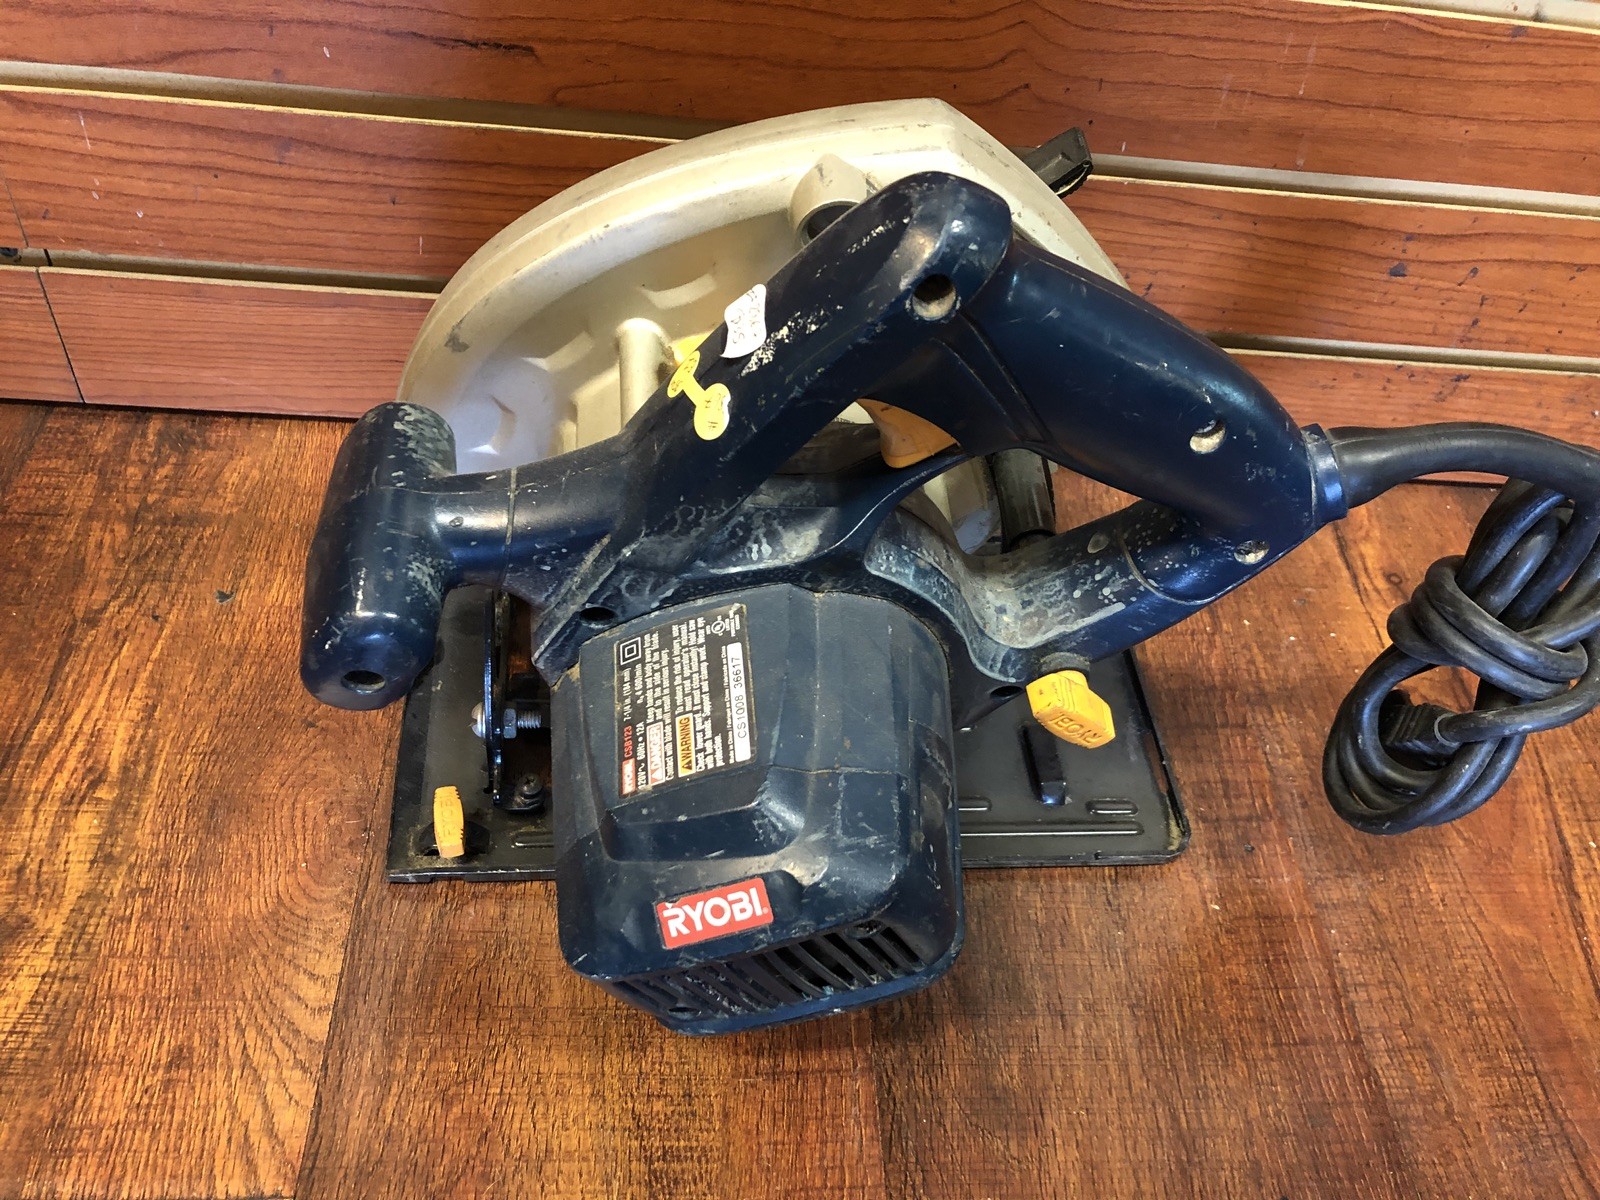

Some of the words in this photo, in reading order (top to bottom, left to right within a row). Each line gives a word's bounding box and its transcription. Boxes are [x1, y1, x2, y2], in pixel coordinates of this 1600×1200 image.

[698, 616, 706, 627] eye
[651, 630, 659, 650] blade.
[679, 621, 688, 646] manual.
[688, 631, 696, 645] Hold
[697, 628, 705, 644] Wear
[645, 647, 653, 663] away
[652, 651, 660, 662] the
[659, 647, 669, 667] injury.
[698, 644, 706, 661] work.
[644, 662, 653, 677] body
[652, 662, 660, 670] of
[673, 662, 681, 675] risk
[699, 661, 710, 680] clamp
[731, 655, 742, 689] 36617
[645, 676, 653, 689] and
[653, 671, 661, 685] side
[661, 666, 669, 688] serious
[673, 674, 682, 685] the
[691, 672, 699, 689] close
[653, 686, 661, 698] the
[683, 679, 691, 694] read
[700, 680, 709, 693] and
[645, 688, 653, 708] hands
[662, 694, 671, 713] result
[674, 685, 683, 706] reduce
[684, 695, 692, 711] must
[692, 689, 700, 705] must
[623, 704, 632, 721] 7-1/4
[675, 706, 683, 714] To
[701, 692, 712, 717] Support
[646, 706, 655, 723] Keep
[655, 707, 663, 720] and
[663, 712, 671, 724] will
[735, 694, 747, 739] CS1008
[636, 721, 645, 736] 12A
[663, 724, 672, 742] blade
[703, 717, 712, 739] hands.
[1047, 713, 1103, 744] RYOBI
[624, 725, 633, 757] CSB123
[649, 725, 662, 769] DANGER
[680, 717, 692, 761] WARNING
[694, 731, 703, 750] lower
[704, 739, 713, 754] both
[636, 741, 645, 760] 60Hz
[664, 742, 673, 756] with
[713, 732, 725, 767] protection.
[665, 756, 674, 780] Contact
[696, 751, 705, 772] Check
[705, 754, 714, 769] with
[663, 887, 763, 938] RYOBI
